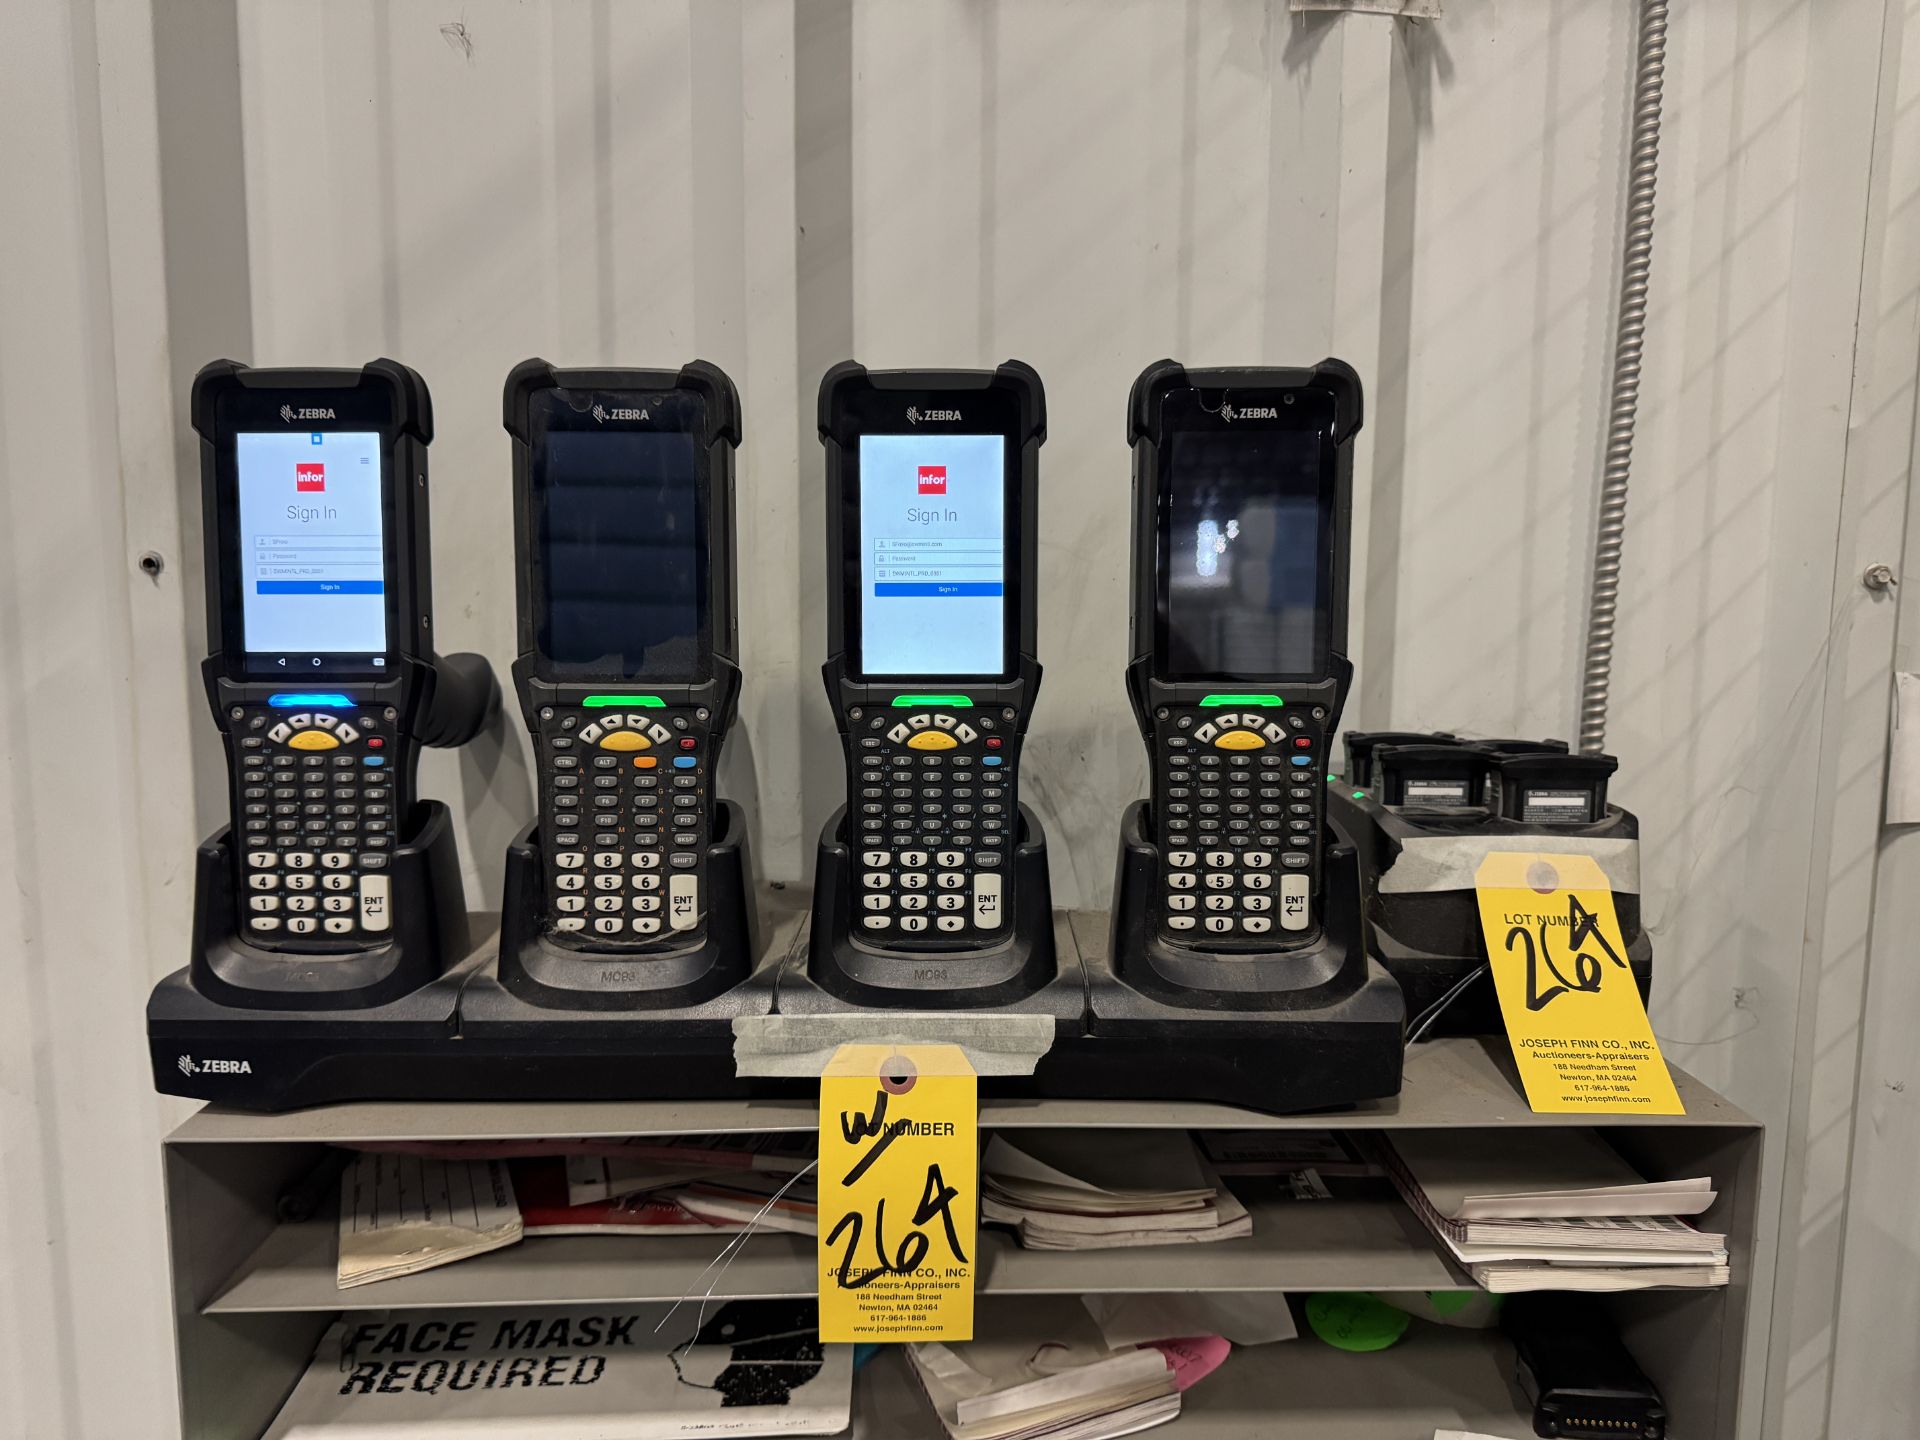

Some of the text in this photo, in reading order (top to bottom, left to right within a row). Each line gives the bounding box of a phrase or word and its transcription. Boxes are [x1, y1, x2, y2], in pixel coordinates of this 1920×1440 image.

[298, 409, 336, 419] ZEBRA
[611, 409, 649, 420] ZEBRA
[924, 410, 962, 420] ZEBRA
[1240, 408, 1277, 418] ZEBRA
[298, 472, 323, 482] infor
[920, 475, 945, 484] infor
[287, 506, 336, 522] Sign In
[907, 508, 957, 524] Sign In
[258, 855, 266, 866] 7
[295, 855, 303, 867] 8
[331, 856, 339, 867] 9
[566, 855, 574, 867] 7
[604, 855, 612, 867] 8
[641, 855, 649, 867] 9
[873, 854, 881, 865] 7
[910, 854, 918, 866] 8
[947, 854, 955, 866] 9
[1179, 854, 1187, 866] 7
[1216, 854, 1224, 866] 8
[1254, 855, 1262, 866] 9
[259, 877, 267, 888] 4
[296, 877, 303, 888] 5
[332, 877, 340, 888] 6
[566, 877, 575, 888] 4
[604, 877, 612, 888] 5
[642, 877, 650, 888] 6
[873, 876, 881, 887] 4
[910, 876, 918, 887] 5
[947, 875, 955, 887] 6
[1178, 876, 1187, 887] 4
[1216, 876, 1224, 888] 5
[1253, 876, 1262, 888] 6
[260, 899, 266, 909] 1
[296, 899, 304, 910] 2
[333, 899, 341, 910] 3
[568, 899, 573, 910] 1
[604, 899, 613, 910] 2
[642, 899, 650, 910] 3
[874, 897, 880, 908] 1
[910, 897, 918, 908] 2
[947, 897, 955, 908] 3
[1179, 897, 1185, 909] 1
[1216, 898, 1224, 909] 2
[1253, 898, 1261, 910] 3
[297, 920, 305, 931] 0
[605, 920, 613, 931] 0
[910, 918, 918, 930] 0
[1216, 919, 1224, 930] 0
[1504, 914, 1599, 927] LOT NUM
[1505, 894, 1627, 1011] 264
[1520, 1039, 1654, 1050] JOSEPH FINN CO., INC.
[1532, 1052, 1649, 1061] Auctioneers-Appraisers
[202, 1060, 252, 1074] ZEBRA
[884, 1122, 954, 1136] NUMBER
[826, 1164, 968, 1289] 264
[828, 1268, 874, 1277] JOSEP
[916, 1268, 941, 1280] CO.,
[946, 1268, 970, 1277] INC.
[838, 1281, 960, 1290] ioneers-Appraisers
[345, 1315, 639, 1354] FACE MASK
[338, 1354, 606, 1395] REQUIRED
